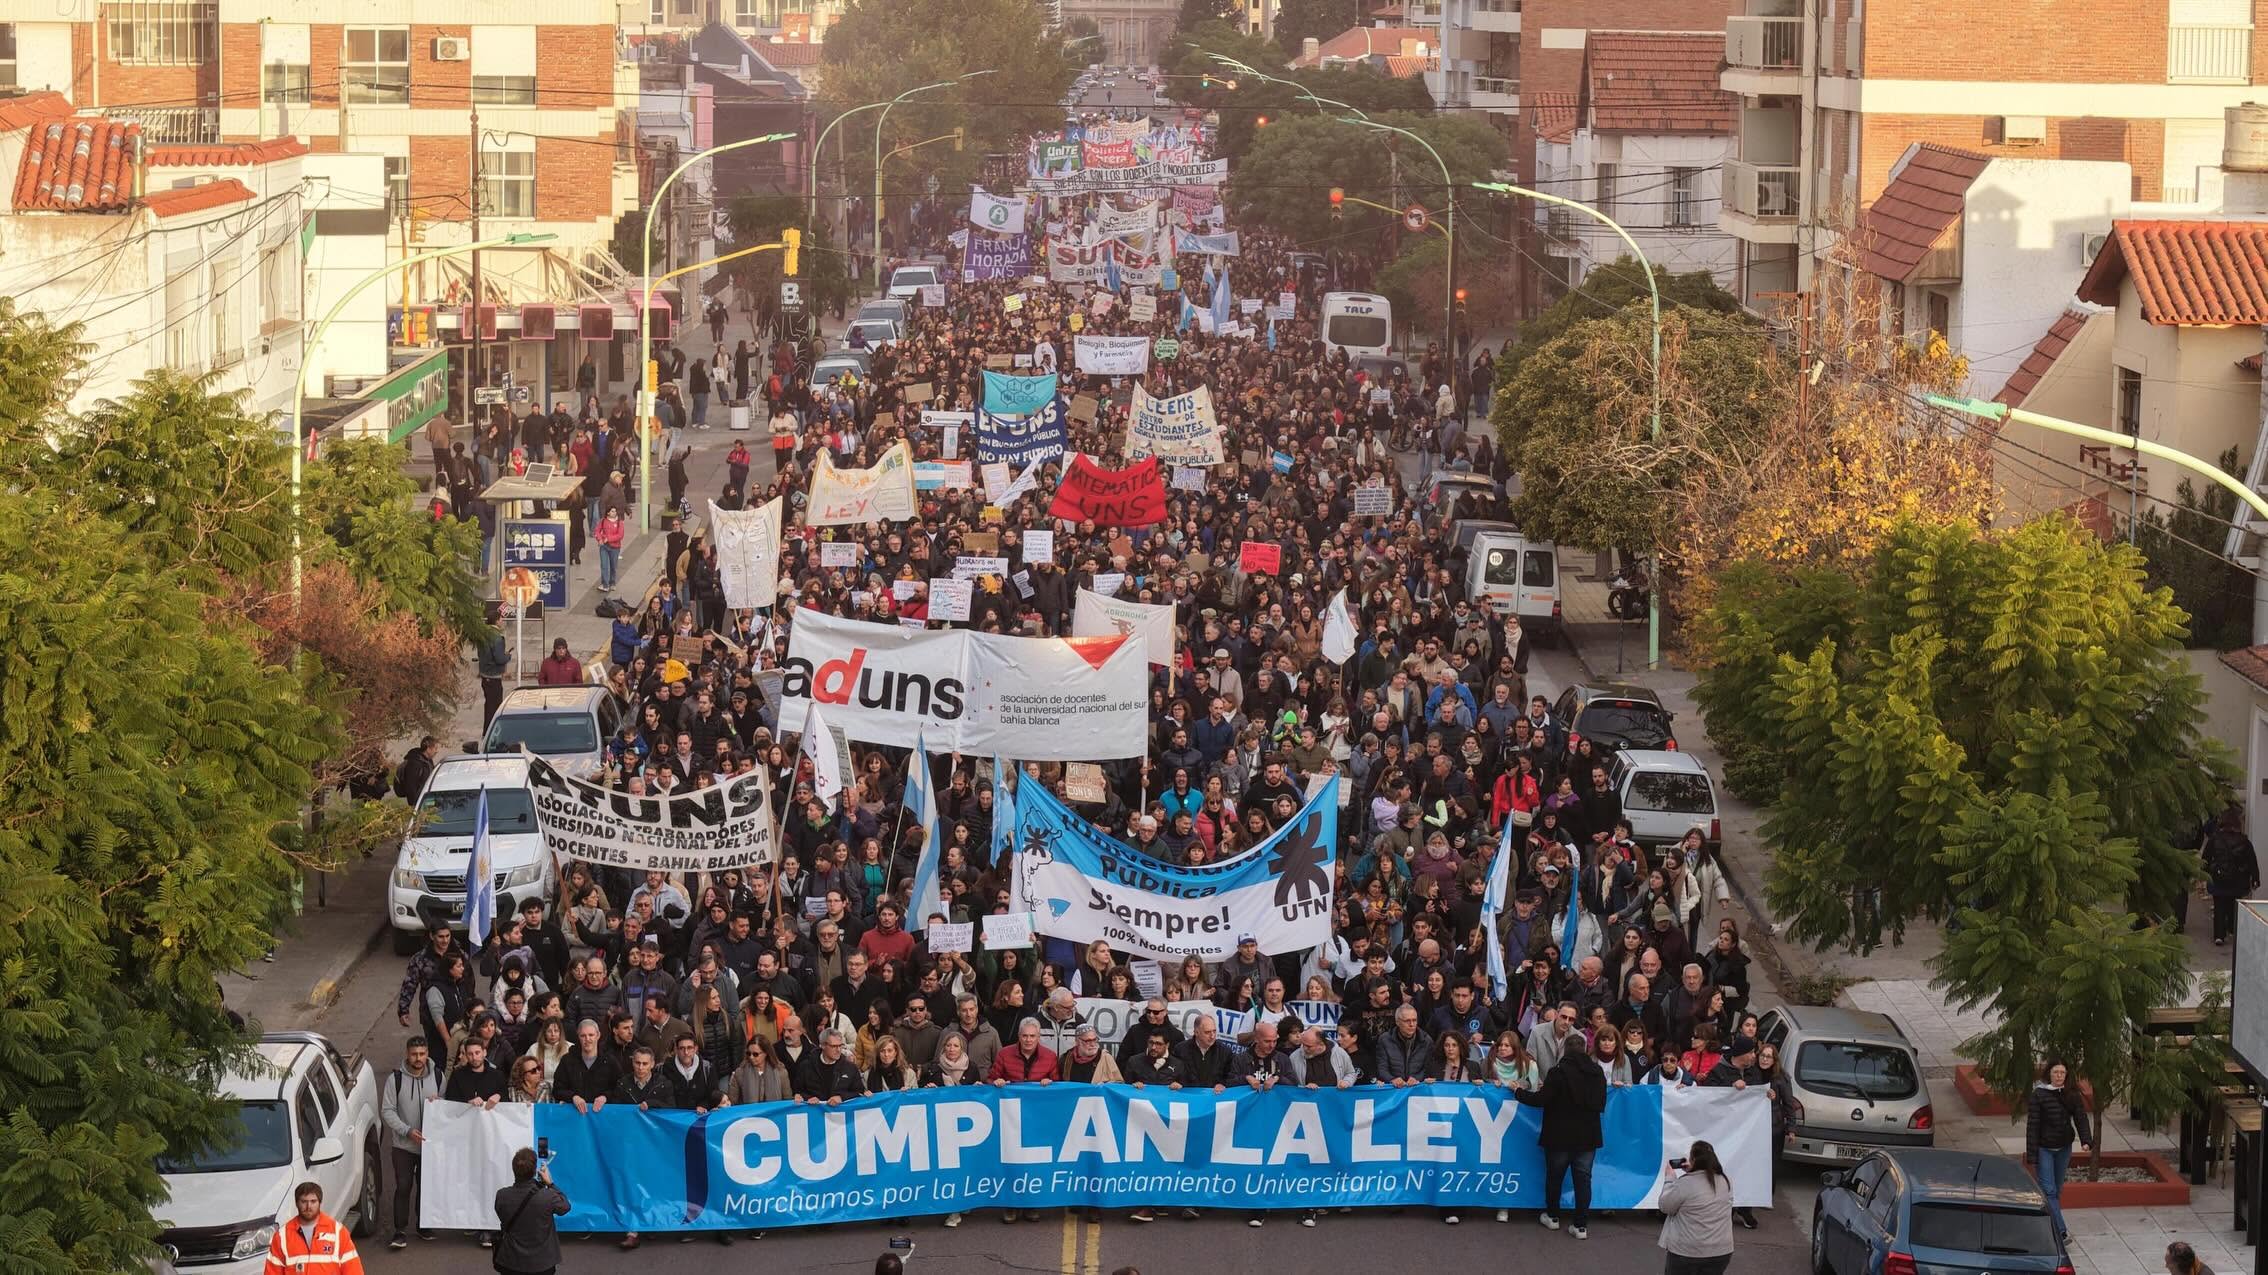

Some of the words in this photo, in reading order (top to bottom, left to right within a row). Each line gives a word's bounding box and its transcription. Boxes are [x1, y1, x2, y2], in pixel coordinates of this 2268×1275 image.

[1123, 162, 1161, 180] DOCENTES
[974, 235, 1027, 251] FRANJA
[973, 249, 1027, 267] MORADA
[1344, 305, 1374, 314] TALP
[1184, 411, 1195, 421] DE
[978, 449, 996, 461] NO
[998, 452, 1020, 464] HAY
[1079, 496, 1149, 520] UNS
[782, 648, 965, 721] aduns
[1000, 693, 1049, 703] asociación
[1050, 693, 1063, 703] de
[1064, 693, 1107, 703] docentes
[1000, 704, 1011, 713] de
[1012, 703, 1022, 713] la
[1023, 703, 1077, 714] universidad
[1078, 702, 1118, 713] nacional
[1119, 701, 1133, 711] del
[1134, 701, 1147, 710] sur
[1028, 715, 1060, 725] blanca
[530, 756, 767, 829] ATUNS
[622, 830, 709, 850] NACIONAL
[713, 837, 741, 850] DEL
[744, 827, 769, 846] SUR
[547, 835, 629, 864] DOCENTES
[707, 849, 767, 870] BLANCA
[1101, 855, 1218, 899] Pública
[1088, 887, 1231, 939] Siempre!
[1282, 896, 1328, 922] UTN
[1103, 926, 1136, 944] 100%
[1139, 938, 1223, 955] Nodocentes
[722, 1096, 1190, 1186] CUMPLAN
[1210, 1101, 1331, 1166] LA
[1351, 1096, 1520, 1164] LEY
[724, 1186, 875, 1216] Marchamos
[882, 1183, 925, 1210] por
[933, 1178, 956, 1200] la
[964, 1175, 1006, 1201] Ley
[1013, 1172, 1042, 1195] de
[1051, 1169, 1237, 1194] Financiamiento
[1245, 1168, 1398, 1195] Universitario
[1440, 1170, 1521, 1194] 27.795
